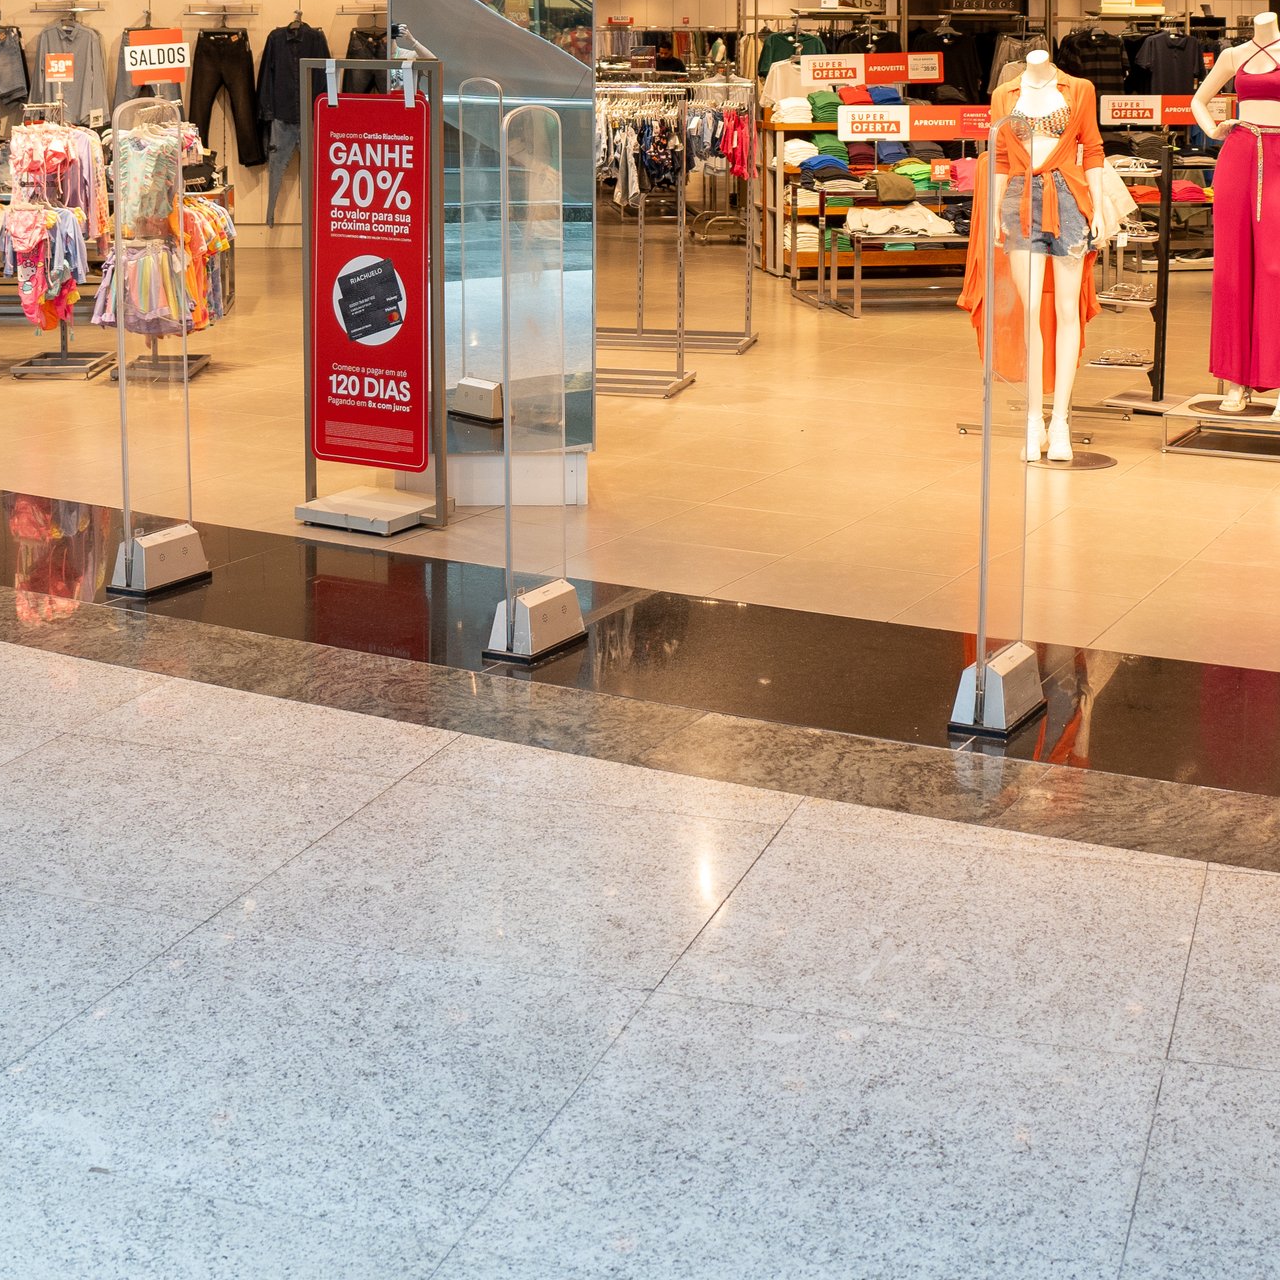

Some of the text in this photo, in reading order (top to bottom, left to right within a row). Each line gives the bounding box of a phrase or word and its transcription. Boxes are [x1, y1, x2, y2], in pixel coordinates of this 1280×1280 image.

[130, 47, 185, 67] SALDOS
[814, 70, 854, 78] OFERTA
[1113, 110, 1151, 118] OFERTA
[853, 123, 897, 132] OFERTA
[330, 131, 345, 139] Pague
[383, 133, 409, 141] Riachuelo
[329, 142, 414, 168] GANHE
[331, 168, 411, 210] 20%
[330, 207, 411, 223] do valor para sua
[331, 218, 370, 231] próxima
[350, 268, 383, 285] RIACHUELO
[332, 363, 360, 373] Comece
[367, 368, 384, 376] pagar
[397, 370, 407, 378] até
[329, 374, 411, 402] 120 DIAS
[328, 396, 355, 406] Pagando
